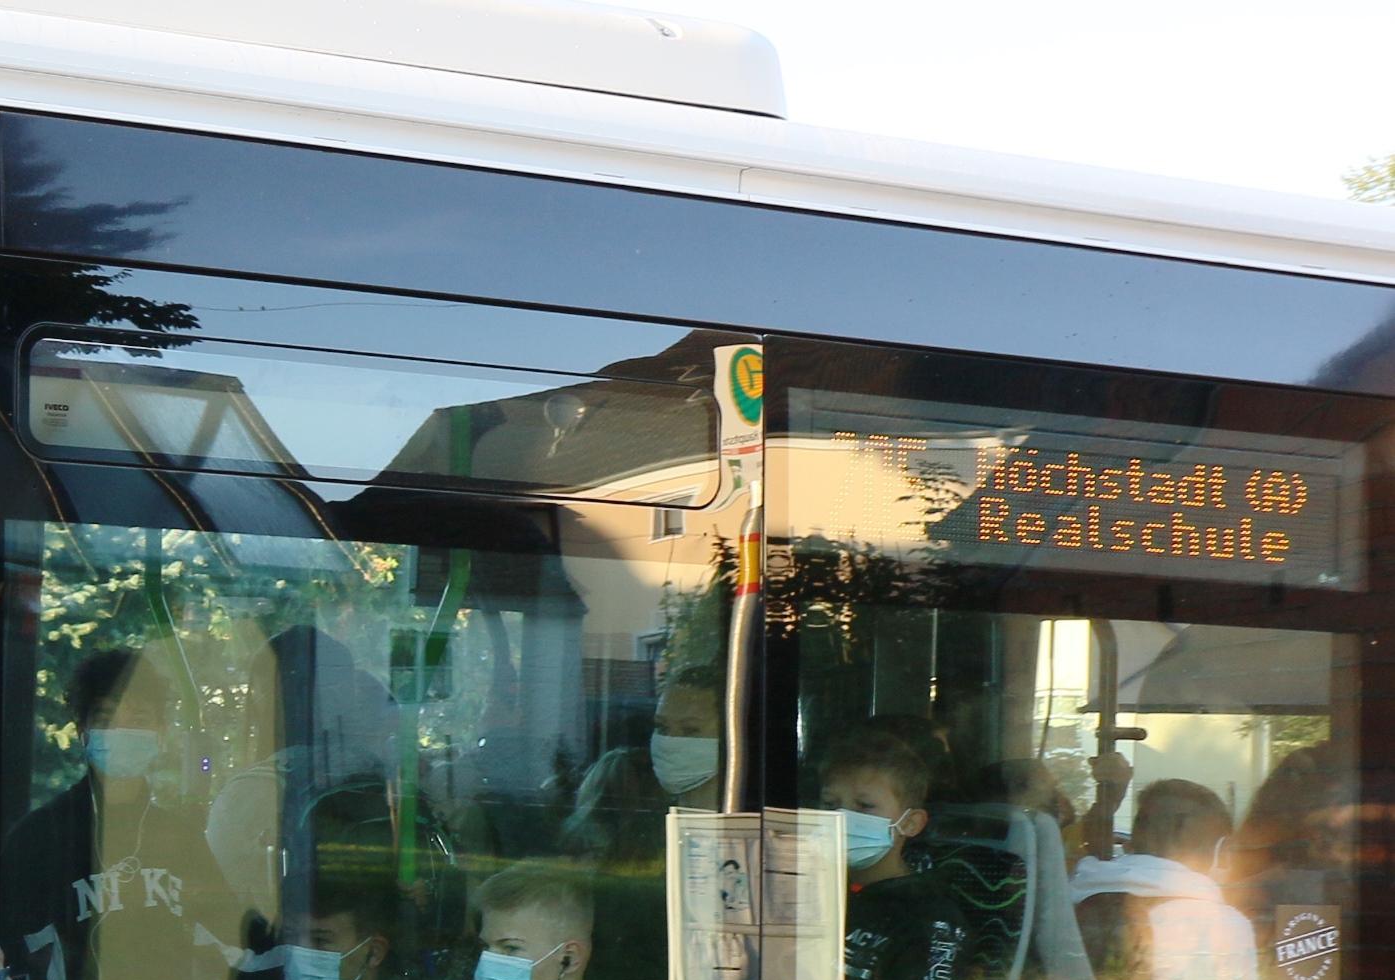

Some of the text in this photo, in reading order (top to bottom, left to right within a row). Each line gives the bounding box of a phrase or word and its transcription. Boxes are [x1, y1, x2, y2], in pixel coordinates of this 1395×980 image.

[977, 446, 1226, 508] Höchstadt
[977, 496, 1291, 563] Realschule
[1275, 929, 1338, 962] FRANCE
